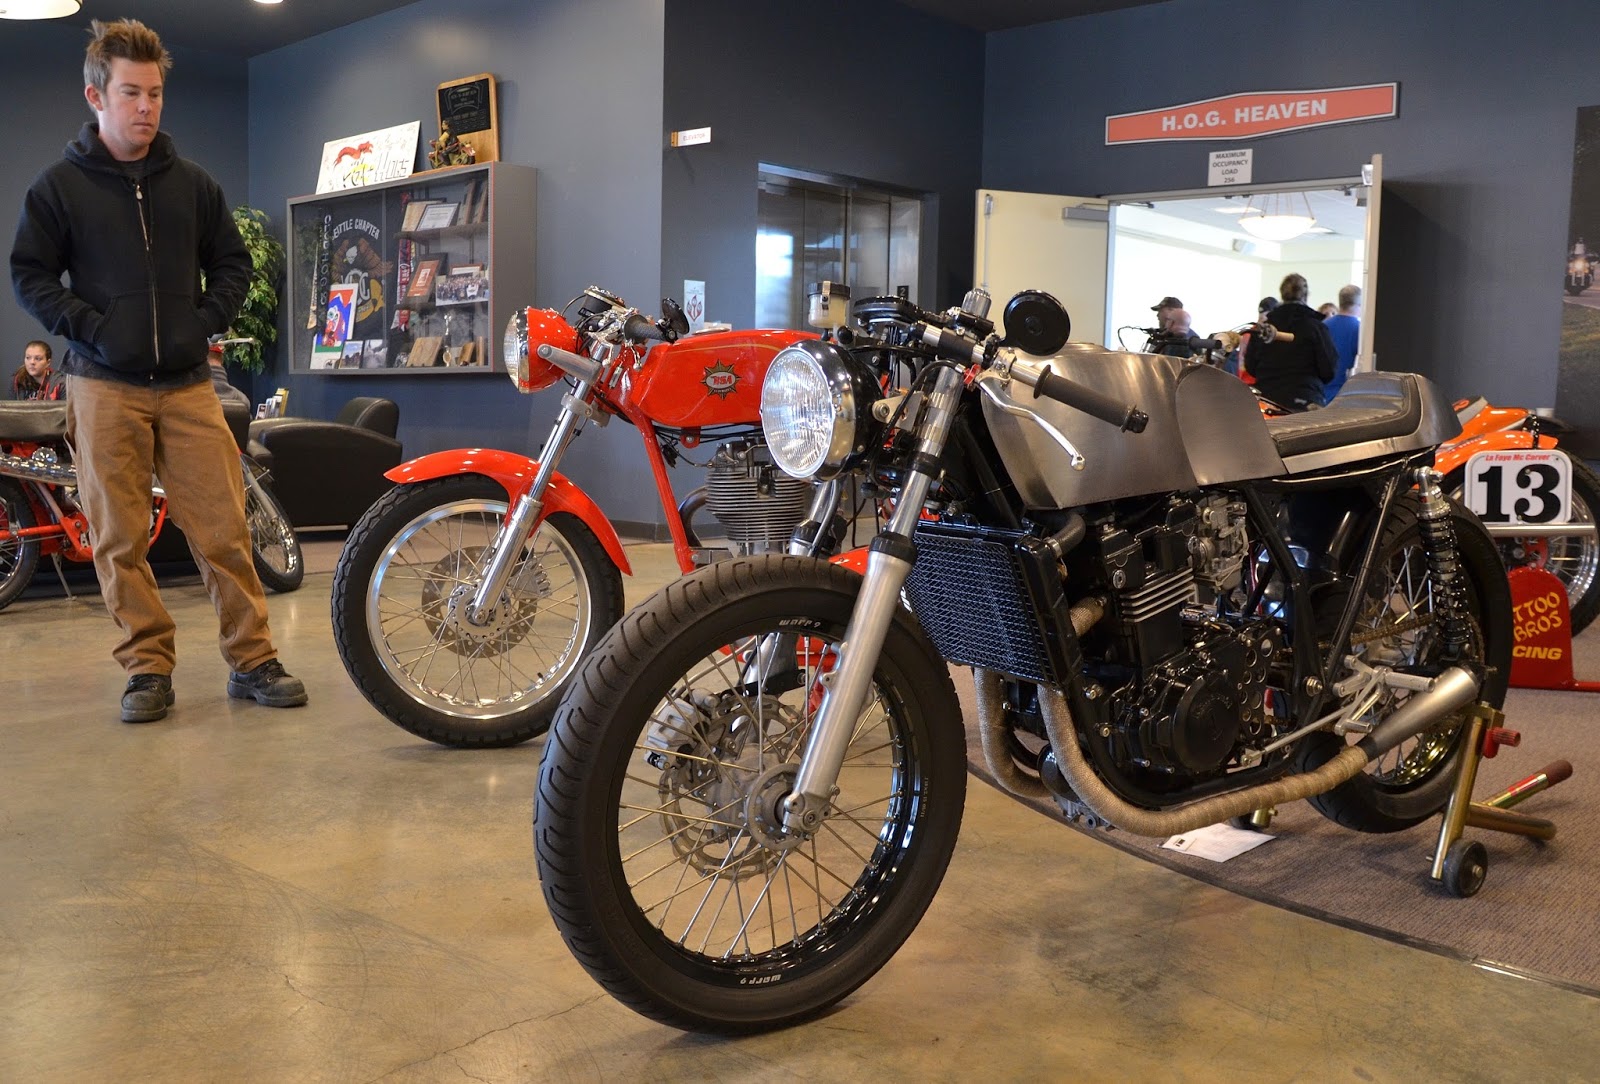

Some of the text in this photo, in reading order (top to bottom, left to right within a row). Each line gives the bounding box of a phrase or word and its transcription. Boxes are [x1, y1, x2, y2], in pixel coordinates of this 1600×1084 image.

[1161, 99, 1328, 132] H.O.G. HEAVEN
[1212, 159, 1249, 168] OCCUPANCY
[1215, 151, 1247, 159] MAXIMUM
[1221, 168, 1239, 176] LOAD
[332, 218, 380, 241] EATTLE CHAPTER
[899, 287, 906, 297] 2
[1477, 463, 1562, 524] 13
[1513, 591, 1561, 624] TTOO
[1513, 610, 1563, 642] BROS
